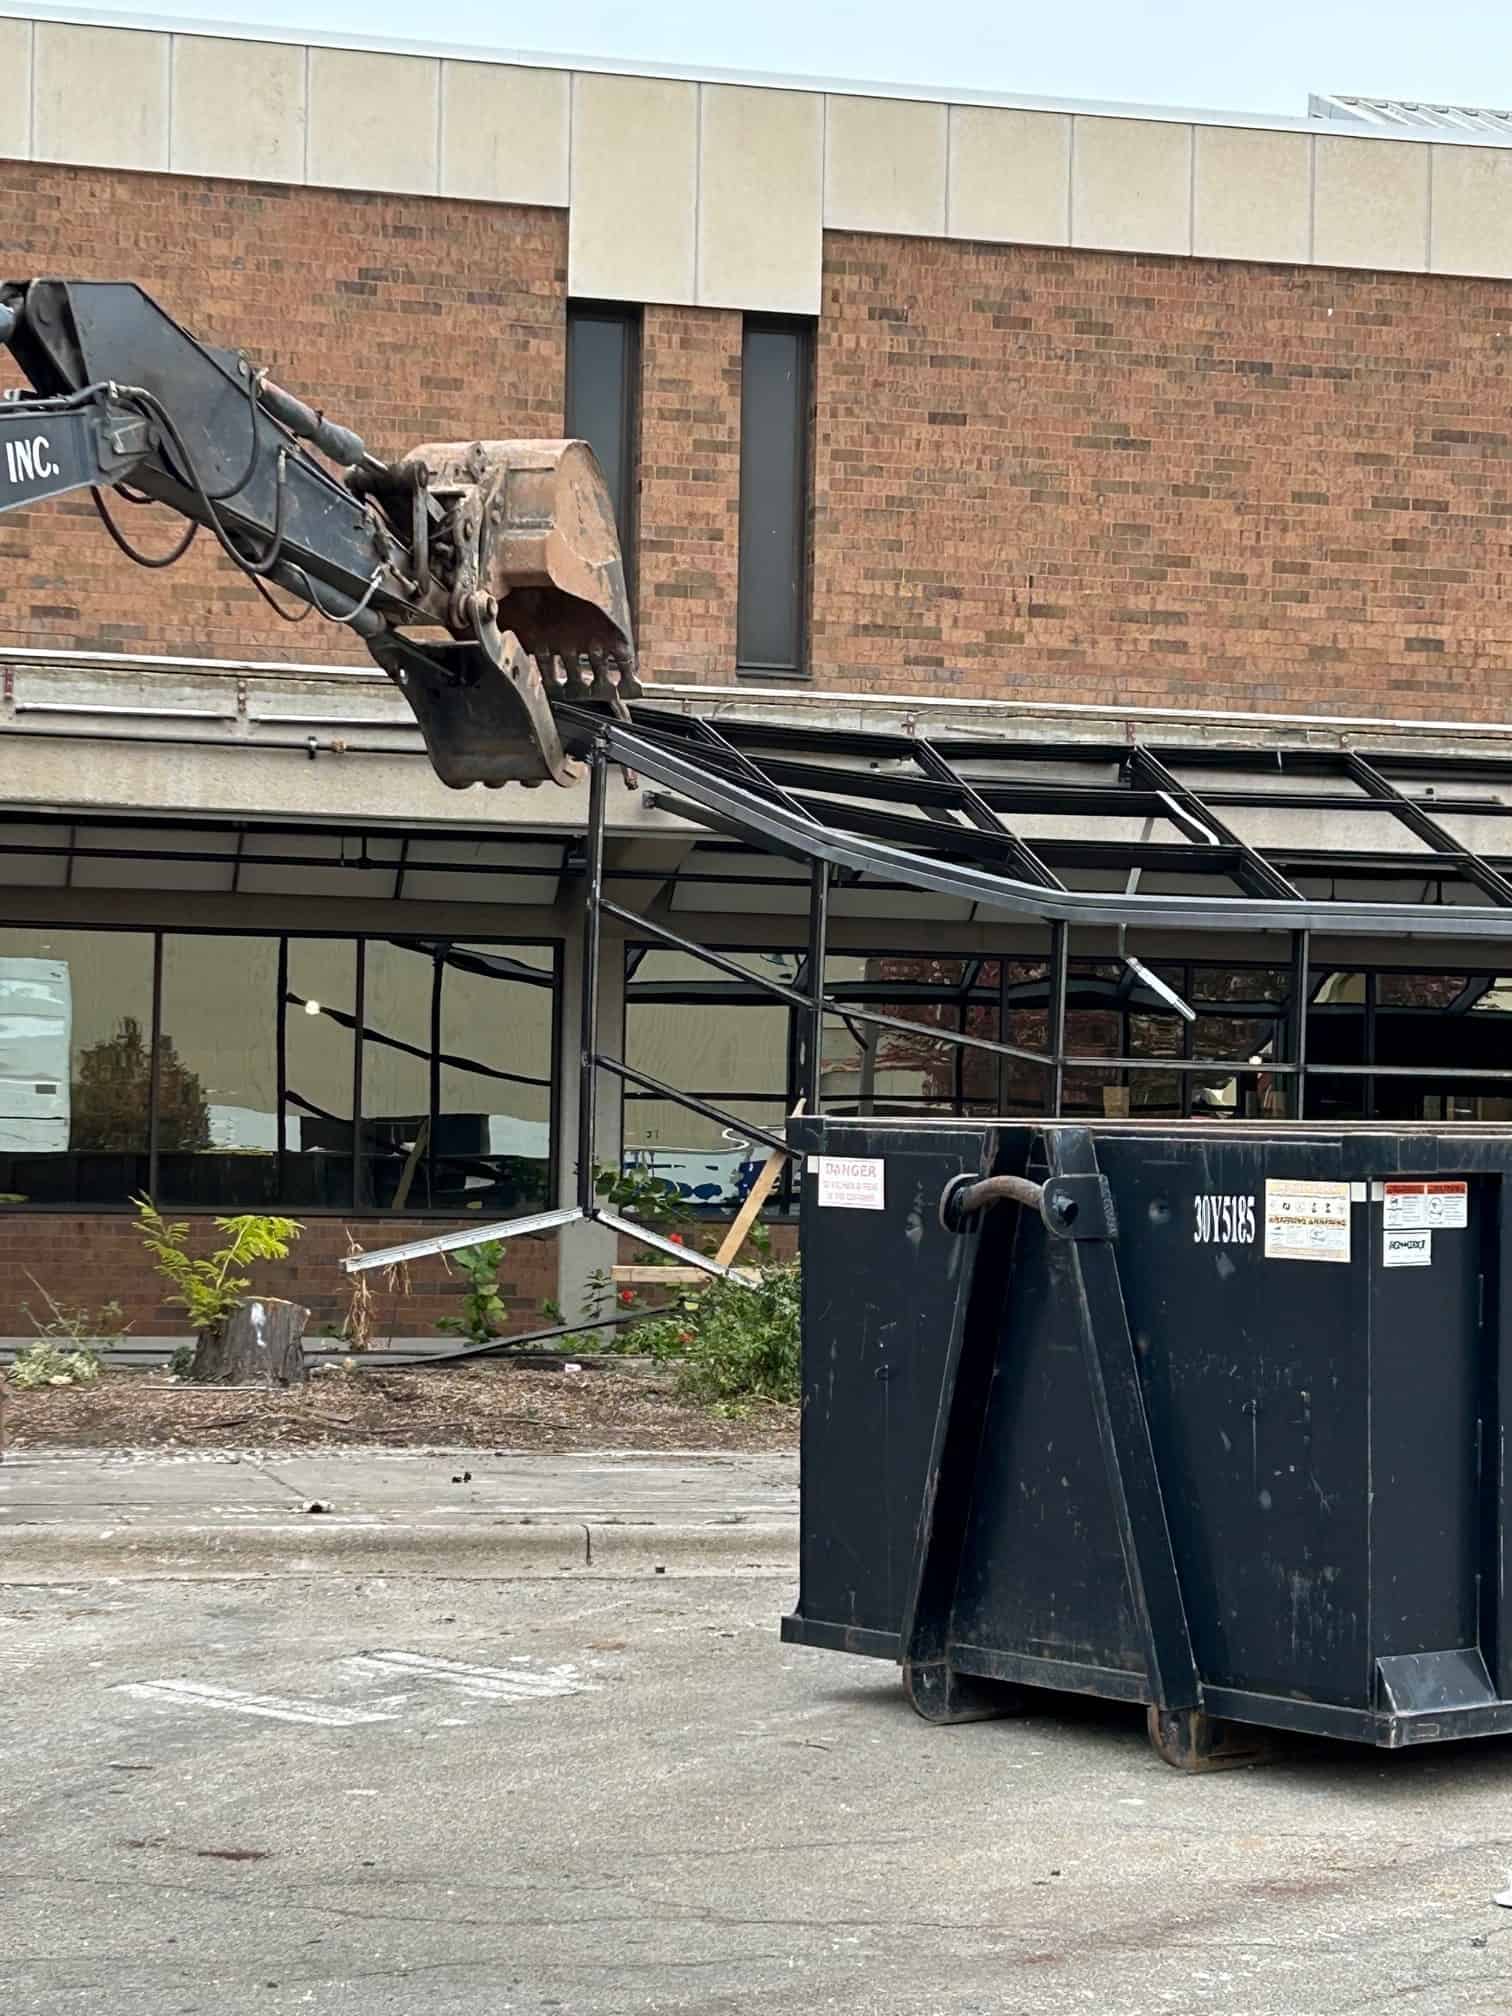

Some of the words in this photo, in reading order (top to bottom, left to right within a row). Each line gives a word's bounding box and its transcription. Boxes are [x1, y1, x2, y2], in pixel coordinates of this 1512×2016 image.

[6, 436, 60, 483] INC.
[825, 1162, 877, 1178] DANGER
[1194, 1195, 1256, 1243] 30Y5185
